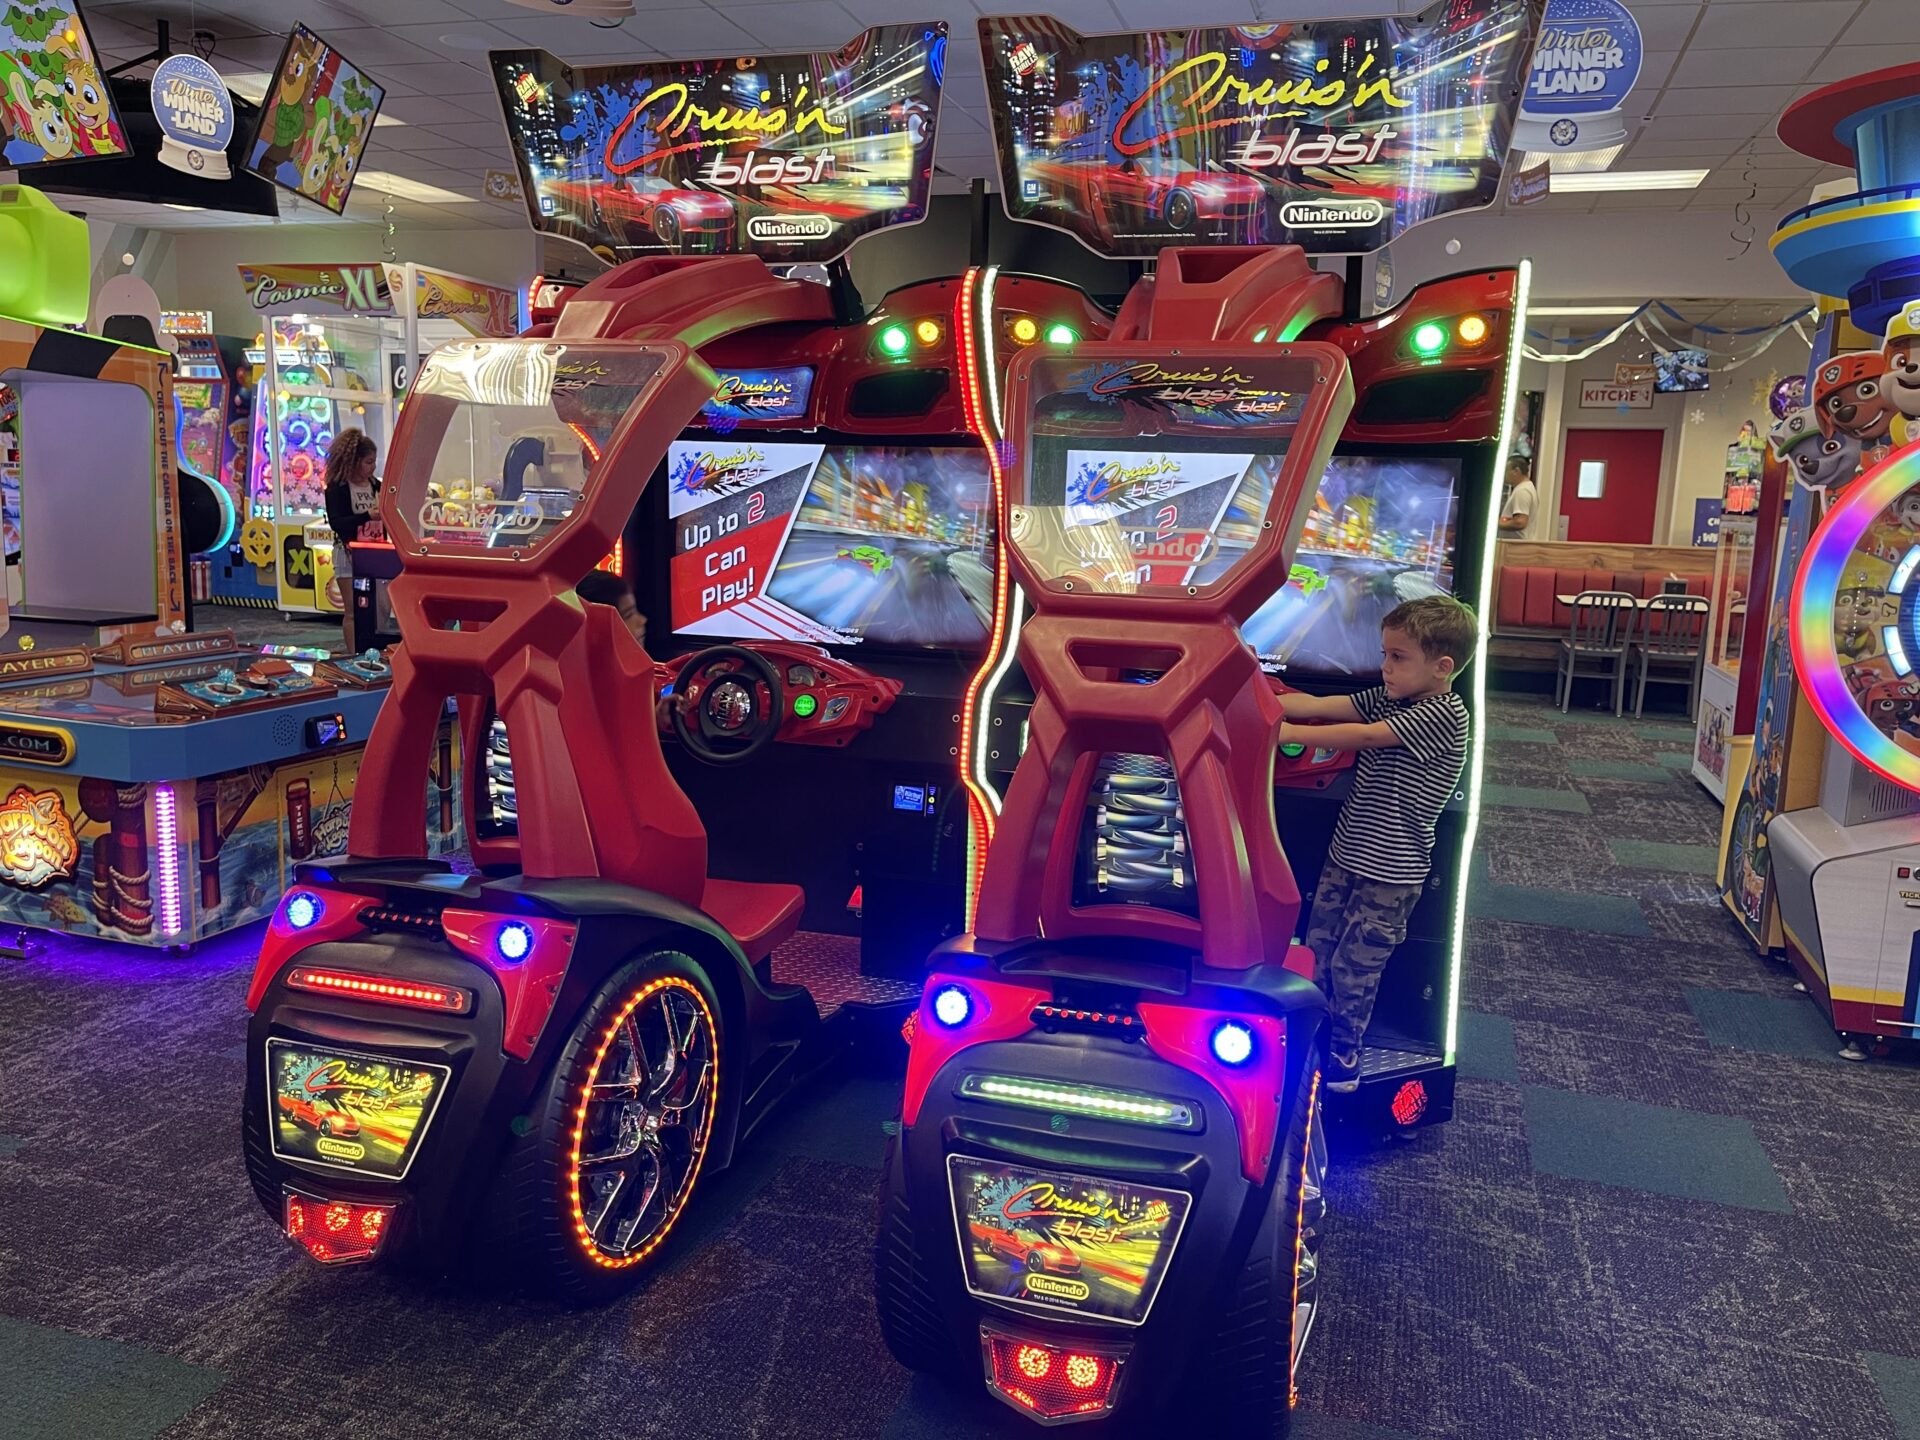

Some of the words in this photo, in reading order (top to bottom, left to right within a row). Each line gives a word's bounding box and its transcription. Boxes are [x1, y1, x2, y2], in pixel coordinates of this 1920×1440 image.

[1537, 26, 1618, 50] Winter
[162, 90, 225, 123] WINNER
[166, 79, 220, 106] Winter
[1113, 52, 1414, 154] Cruis'n
[606, 83, 846, 174] Cruis'n
[1236, 123, 1398, 168] blast
[704, 148, 836, 186] blast
[754, 222, 825, 235] Nintendo
[1288, 208, 1374, 222] Nintendo
[252, 276, 344, 308] Cosmic
[338, 267, 391, 311] XL
[1093, 363, 1252, 394] Cruis'n
[157, 391, 166, 424] CHECK
[159, 428, 167, 447] OUT
[163, 473, 172, 515] CAMERA
[166, 519, 173, 532] ON
[307, 528, 335, 541] TICKE
[684, 526, 712, 550] Up
[718, 515, 739, 537] to
[746, 491, 766, 524] 2
[705, 545, 746, 576] Can
[702, 567, 754, 611] Play!
[141, 640, 207, 657] PLAYER
[0, 812, 71, 860] arpoon
[313, 815, 348, 842] Harpo
[343, 1090, 393, 1111] blast
[321, 1142, 361, 1157] Nintendo
[1003, 1183, 1129, 1223] Cruis'n
[1055, 1219, 1122, 1243] blast
[1031, 1277, 1083, 1296] Nintendo
